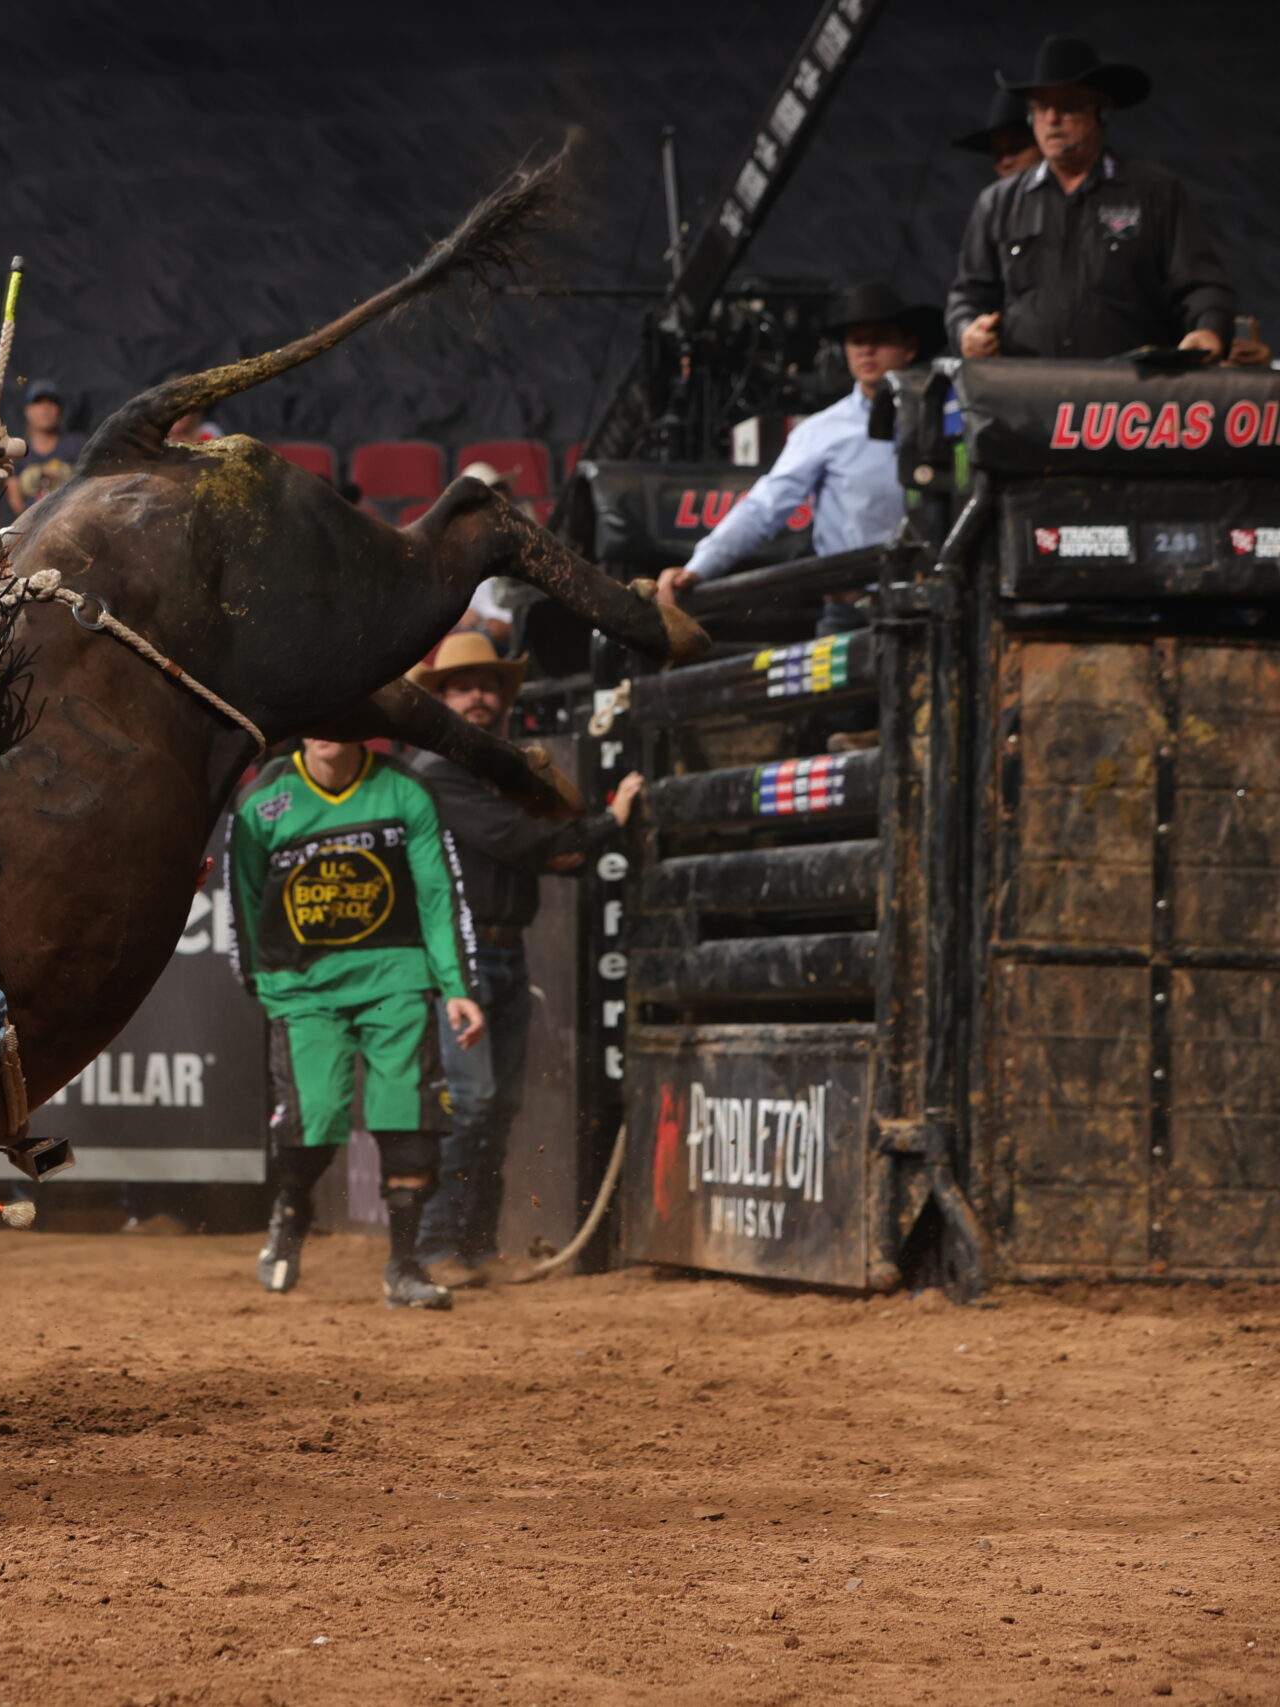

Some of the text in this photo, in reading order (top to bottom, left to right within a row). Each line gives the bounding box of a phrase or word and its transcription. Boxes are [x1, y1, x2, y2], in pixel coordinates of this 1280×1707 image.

[1050, 400, 1280, 450] LUCAS OI
[675, 489, 814, 531] LUS
[686, 1082, 826, 1203] PENDLETON
[711, 1196, 786, 1240] WHISKY
